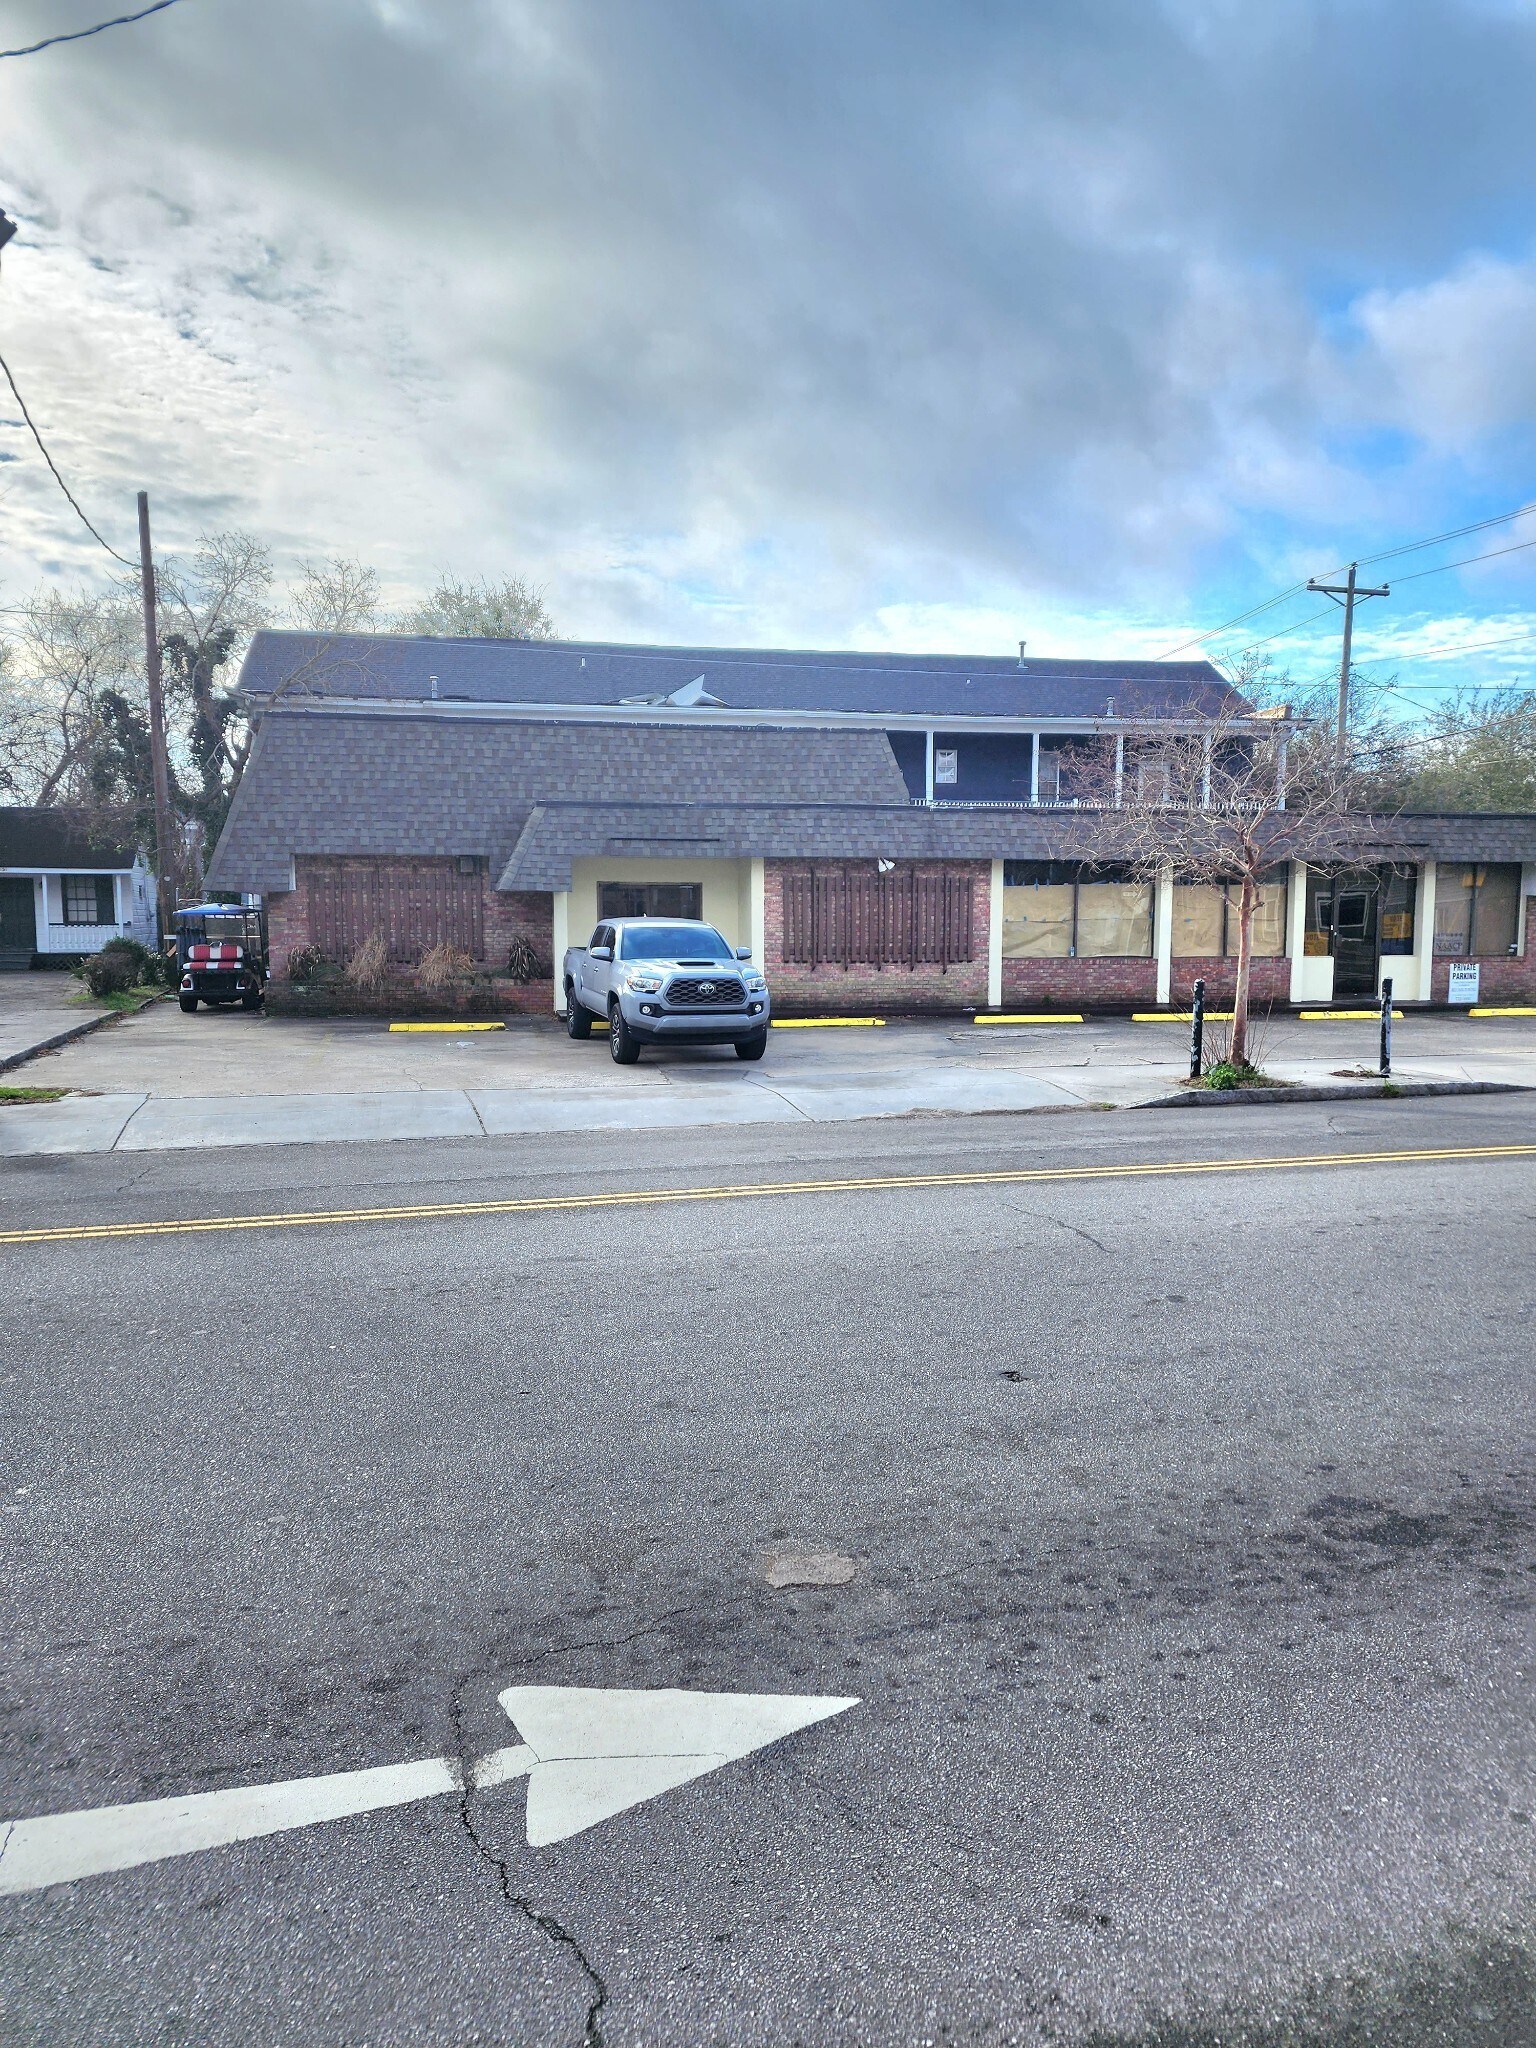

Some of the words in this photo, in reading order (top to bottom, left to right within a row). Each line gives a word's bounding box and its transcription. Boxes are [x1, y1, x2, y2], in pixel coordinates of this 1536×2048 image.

[1435, 942, 1462, 950] NAACP
[1453, 963, 1476, 971] PRIVATE
[1452, 972, 1476, 980] PARKING
